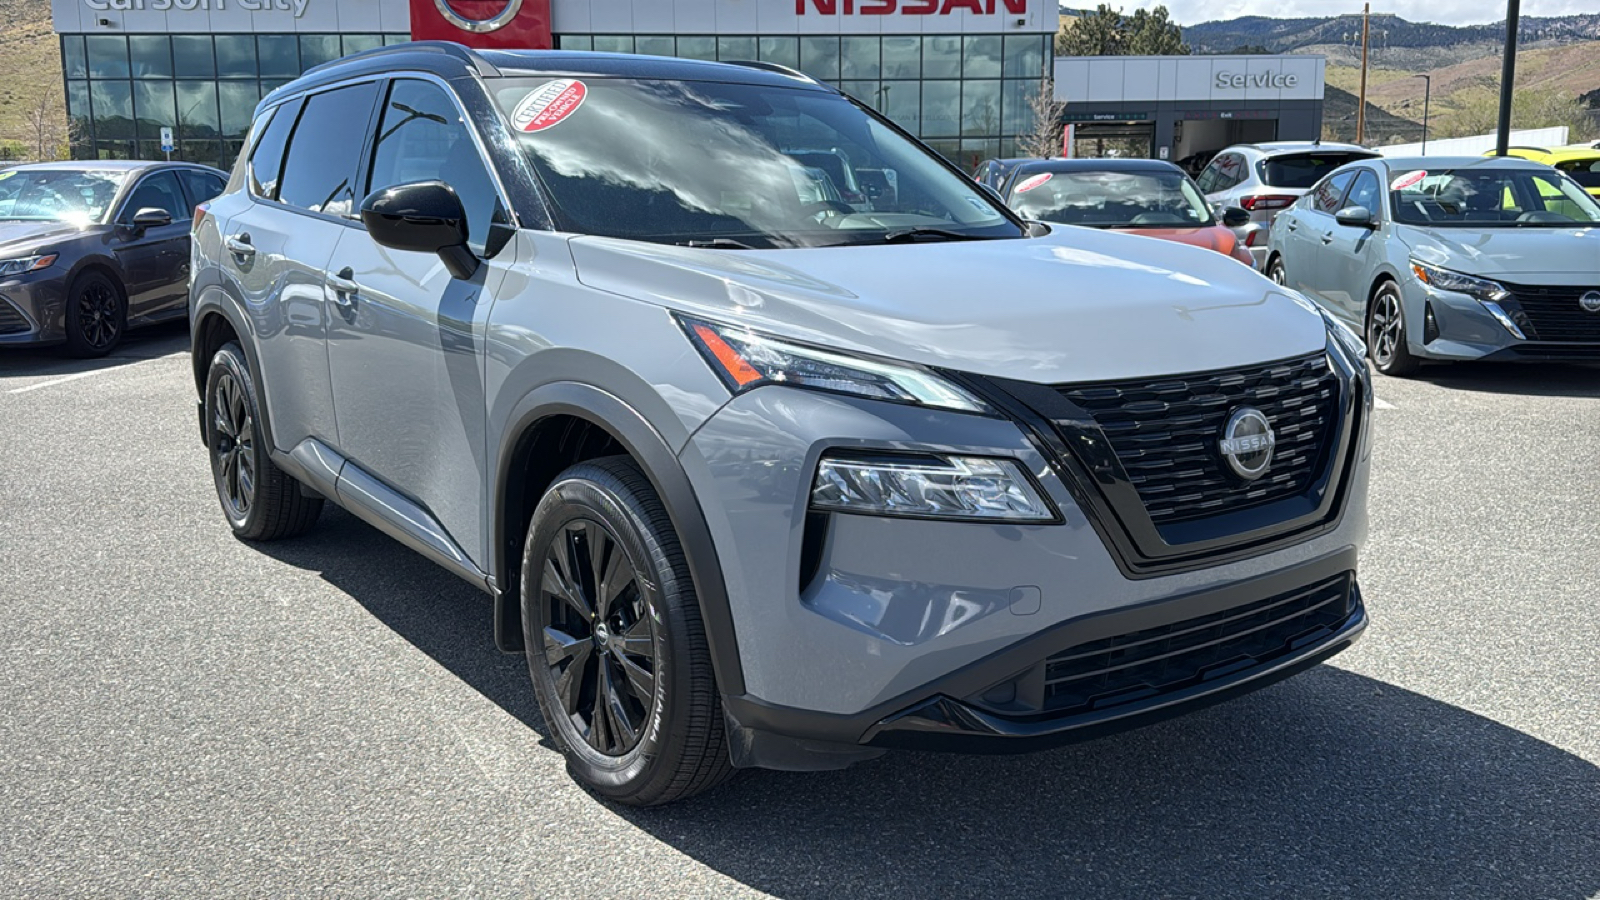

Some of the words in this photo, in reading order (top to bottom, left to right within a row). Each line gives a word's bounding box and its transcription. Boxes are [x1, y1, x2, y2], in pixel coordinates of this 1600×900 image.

[1216, 69, 1298, 89] Service
[516, 81, 566, 122] CERTIFIED
[534, 86, 577, 125] PRE-OWNED
[549, 94, 581, 120] VEHICLE
[1223, 433, 1275, 452] NISSAN
